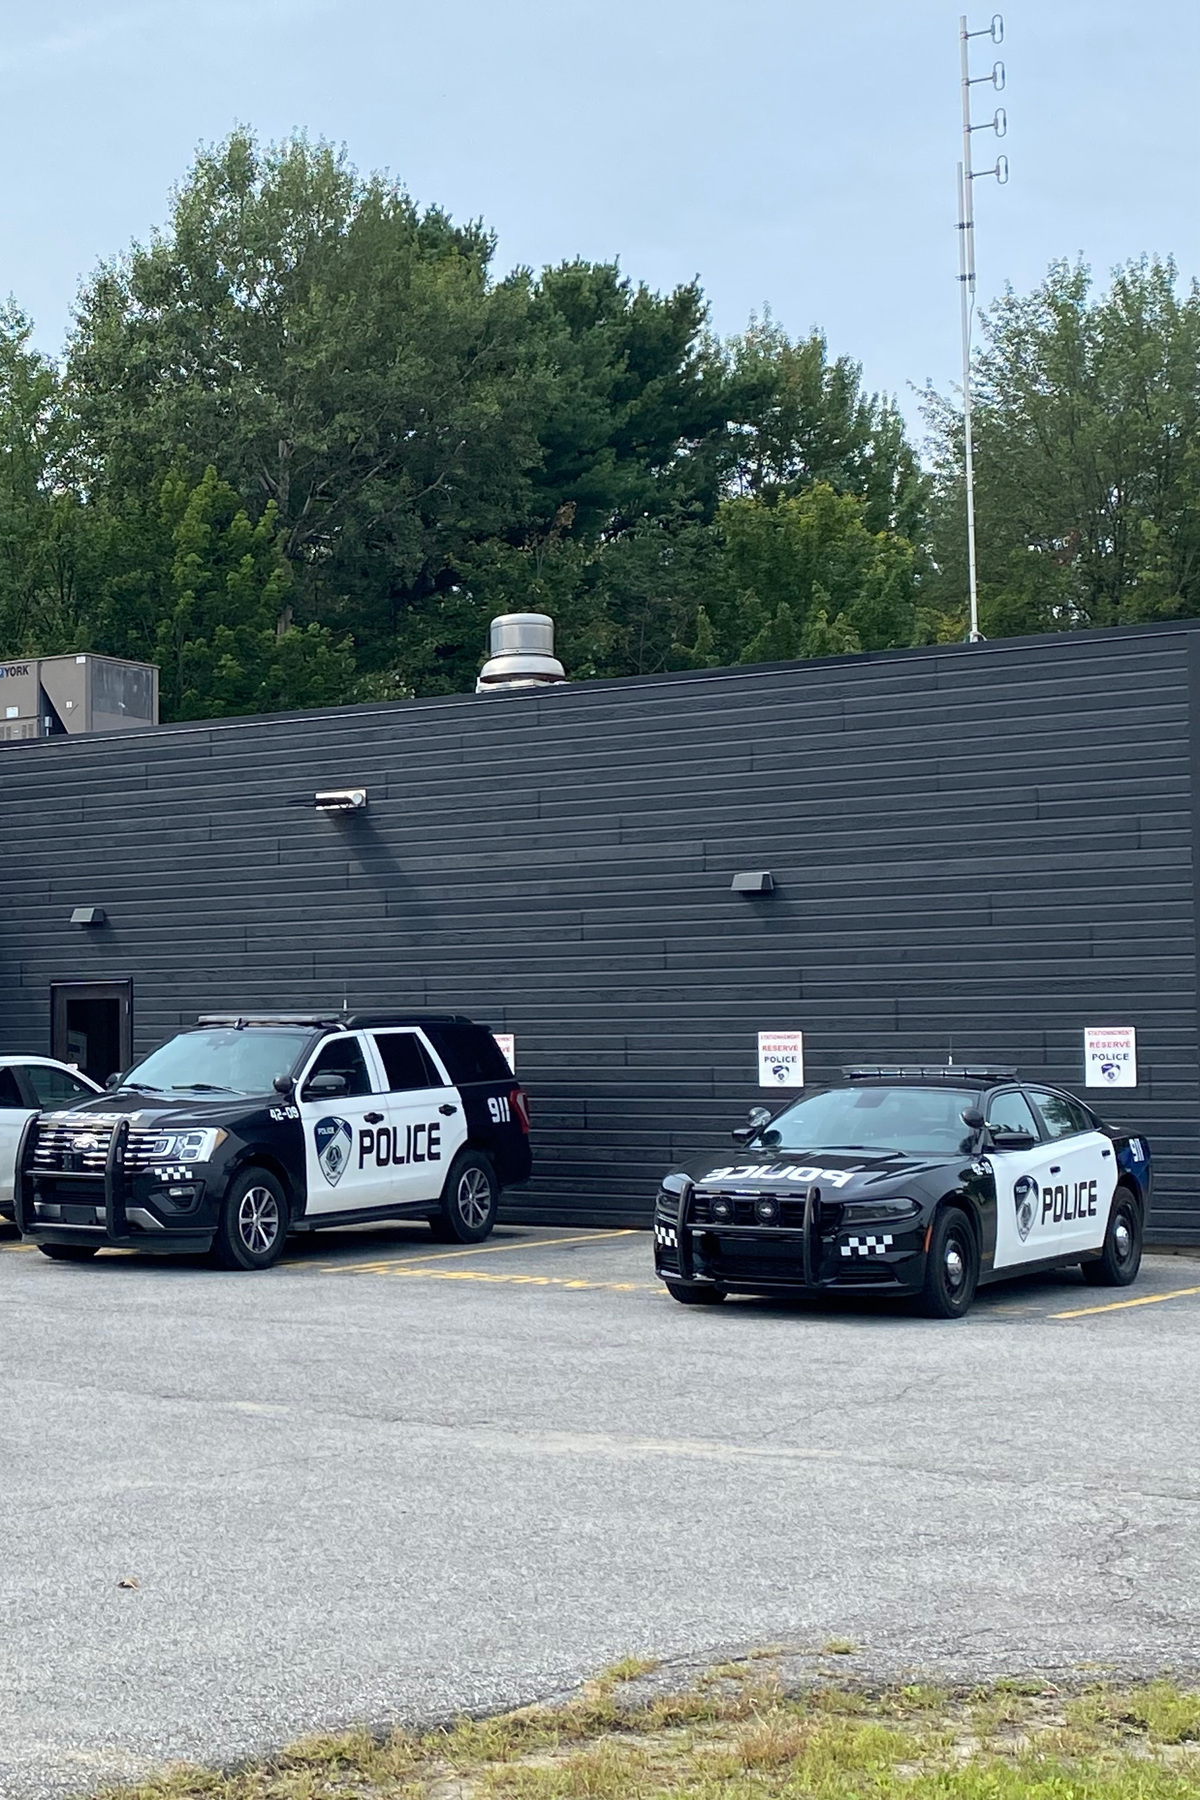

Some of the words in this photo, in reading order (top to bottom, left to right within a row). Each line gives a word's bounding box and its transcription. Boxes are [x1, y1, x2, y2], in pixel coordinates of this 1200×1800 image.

[4, 665, 29, 677] YORK
[764, 1055, 797, 1063] POLICE
[1092, 1053, 1129, 1061] POLICE
[269, 1106, 299, 1121] 42-09
[487, 1096, 511, 1123] 911
[358, 1122, 441, 1169] POLICE
[1128, 1138, 1145, 1162] 911
[1041, 1180, 1097, 1225] POLICE
